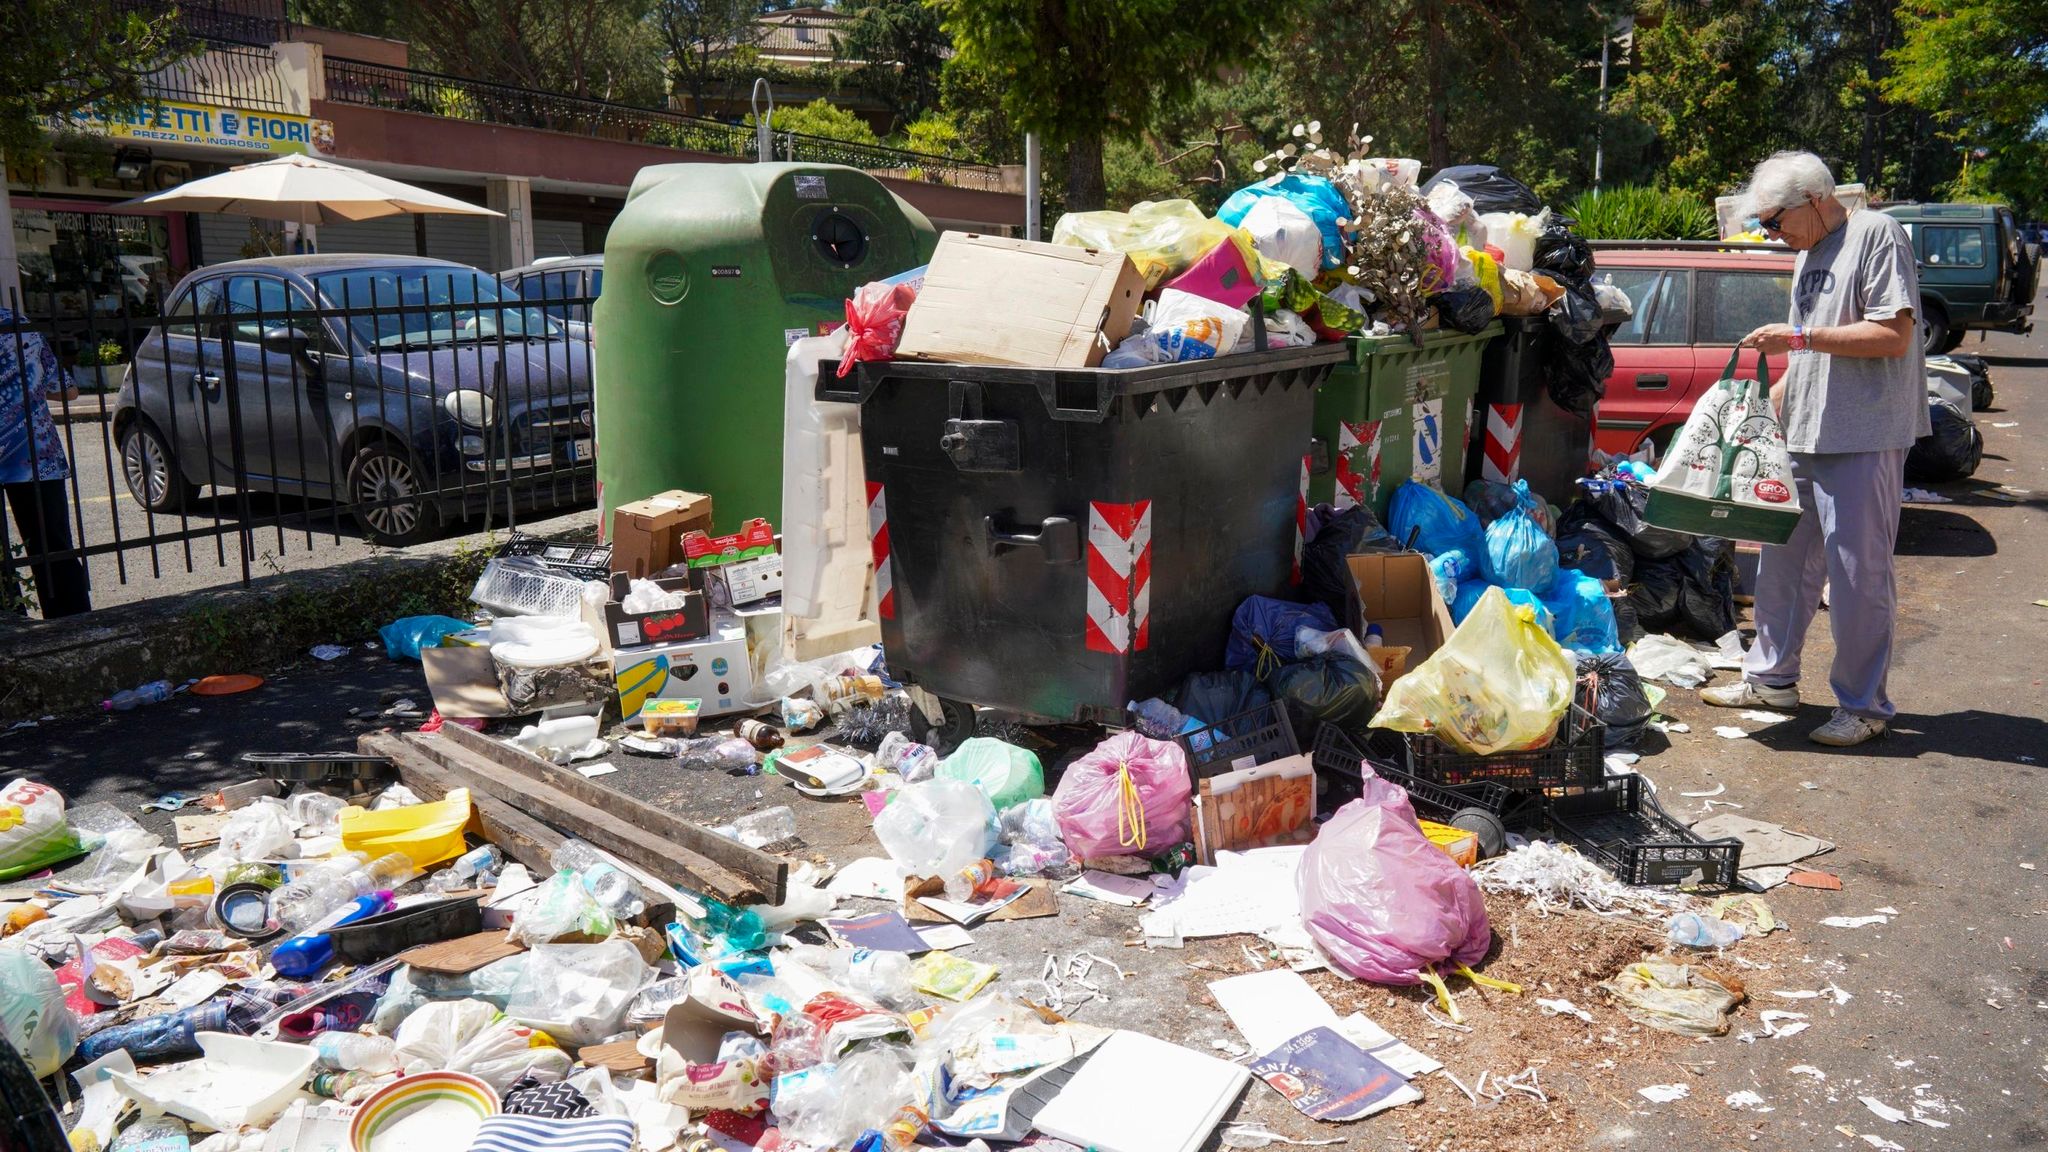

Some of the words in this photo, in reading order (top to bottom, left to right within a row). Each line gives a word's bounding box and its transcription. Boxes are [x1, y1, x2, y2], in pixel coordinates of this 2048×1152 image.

[73, 101, 211, 133] NFETTI
[222, 113, 239, 136] E
[247, 116, 310, 143] FIORI
[132, 129, 179, 141] PREZZI
[206, 137, 270, 150] INGROSSO
[53, 213, 85, 231] ARGENTI
[90, 214, 111, 232] LISTE
[1758, 482, 1787, 495] GROS
